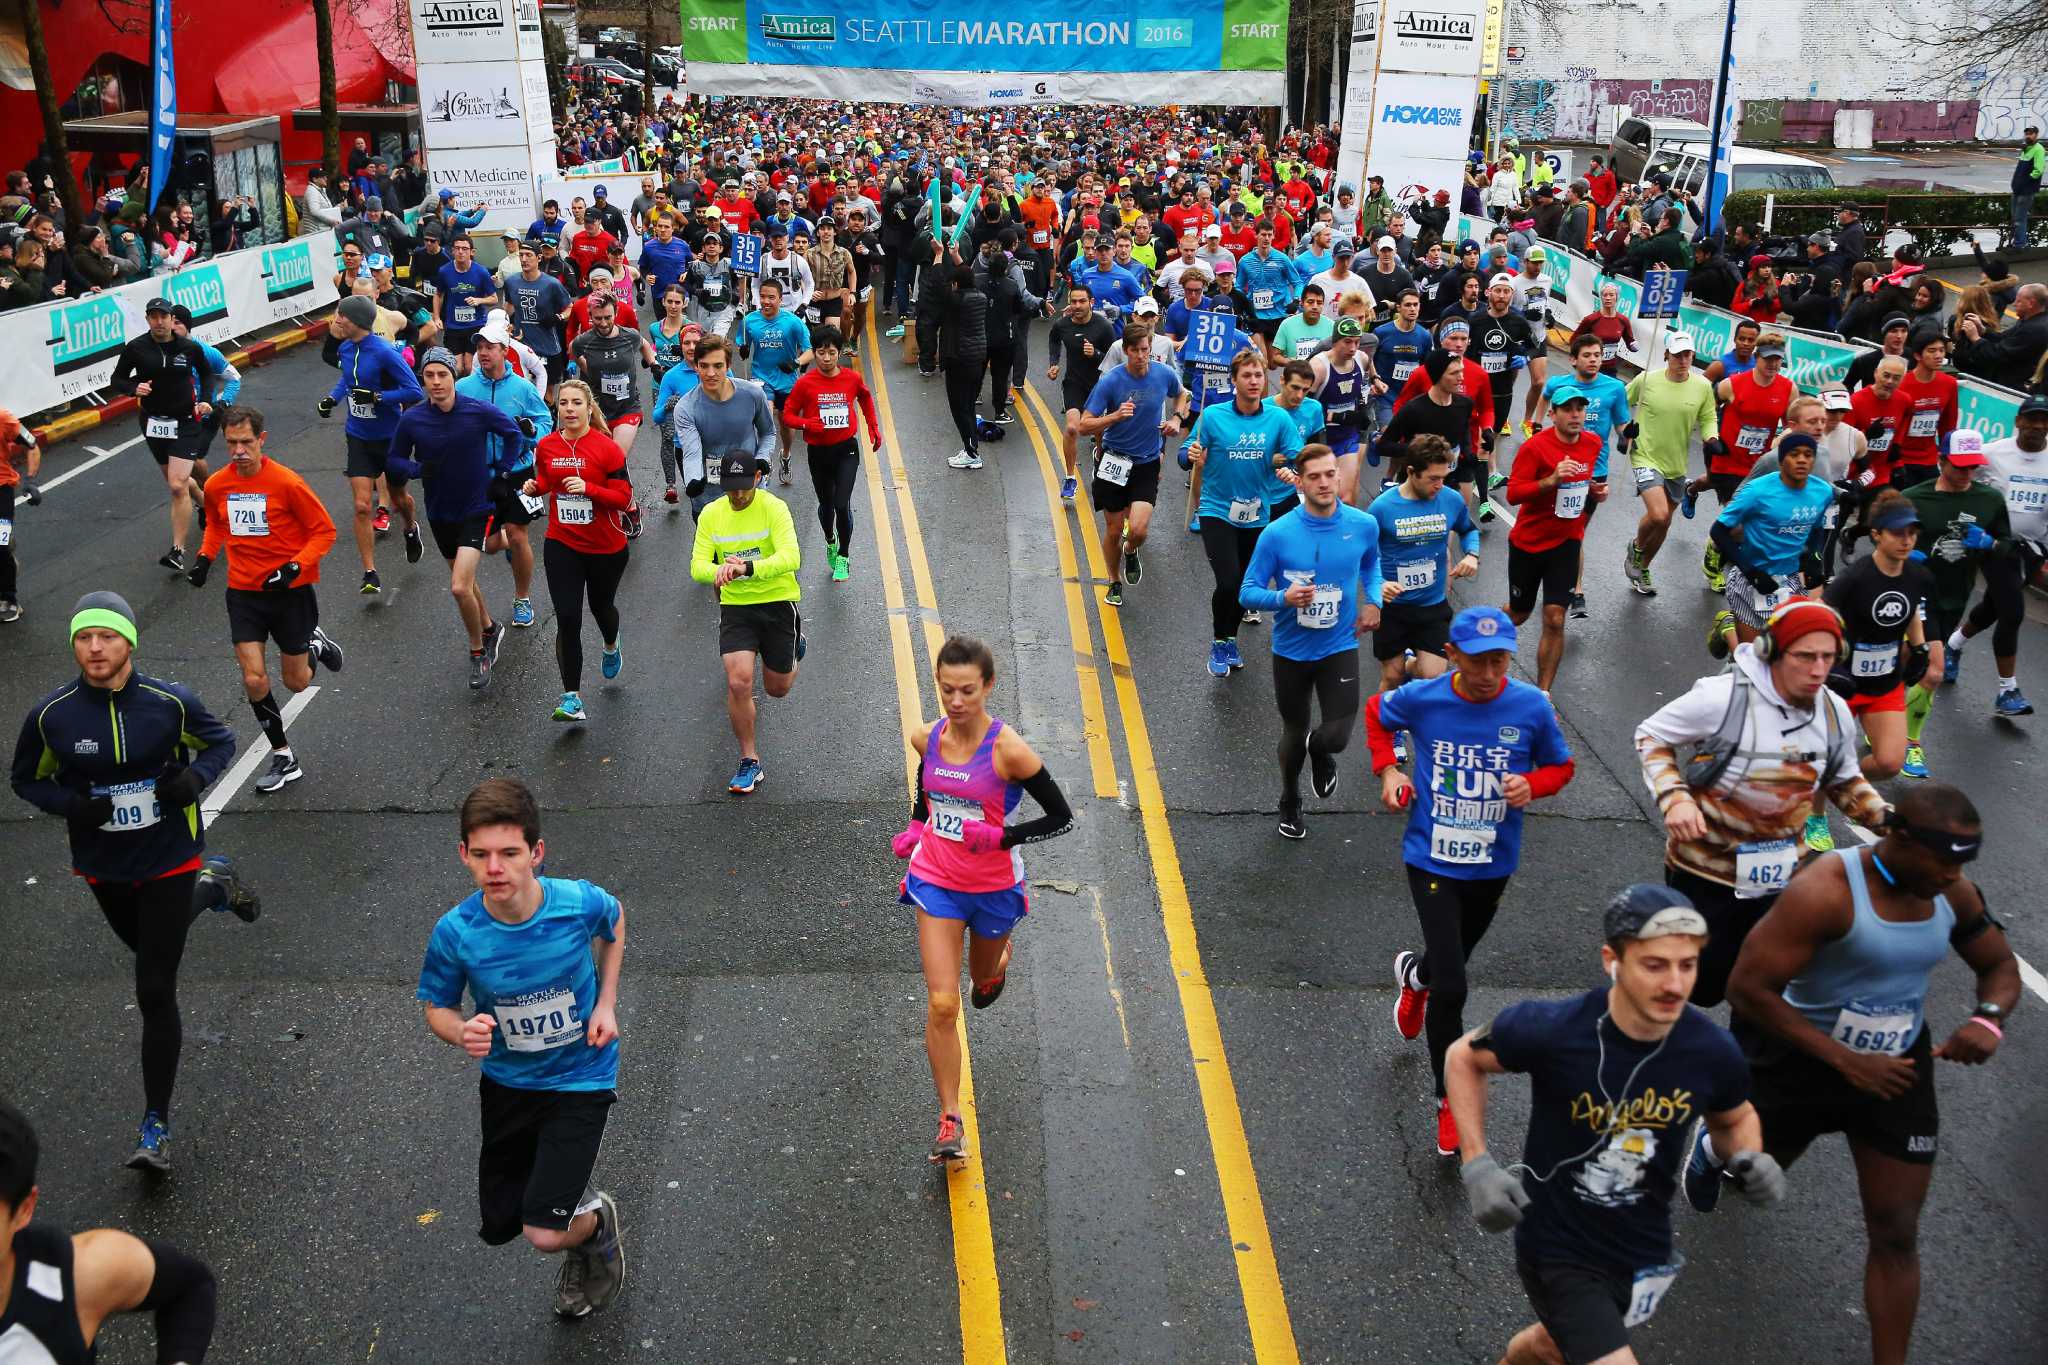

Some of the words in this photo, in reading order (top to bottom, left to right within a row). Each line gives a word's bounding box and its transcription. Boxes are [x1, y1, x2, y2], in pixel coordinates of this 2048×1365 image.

[424, 3, 498, 23] Amica
[1353, 6, 1375, 31] mica
[689, 17, 738, 30] START
[764, 16, 831, 36] Amica
[1396, 11, 1470, 34] Amica
[1143, 26, 1183, 42] 2016
[1231, 24, 1280, 38] START
[989, 89, 1013, 98] HOKA
[1382, 105, 1439, 125] HOKA
[1439, 108, 1461, 117] ONE
[1439, 117, 1462, 126] ONE
[433, 171, 462, 184] UW
[464, 168, 528, 183] Medicine
[483, 189, 508, 197] SPINE
[510, 188, 516, 196] &
[496, 195, 528, 205] HEALTH
[736, 235, 755, 250] 3h
[737, 251, 754, 264] 15
[266, 249, 310, 288] Amica
[522, 308, 537, 320] 15
[54, 306, 123, 357] Amica
[1196, 315, 1226, 335] 3h
[1197, 335, 1223, 354] 10
[659, 355, 682, 363] PACER
[1195, 363, 1229, 373] MARATHON
[61, 380, 82, 397] AUTO
[87, 371, 109, 387] HOME
[606, 384, 622, 393] 654
[823, 415, 845, 426] 1662
[151, 425, 169, 437] 430
[1229, 451, 1264, 460] PACER
[1563, 496, 1581, 508] 302
[2009, 490, 2038, 504] 1648
[234, 510, 256, 524] 720
[561, 508, 586, 521] 1504
[1394, 513, 1447, 526] CALIFORNIA
[1396, 524, 1447, 537] MARATHON
[1405, 572, 1427, 586] 393
[1861, 659, 1885, 674] 917
[1432, 738, 1512, 771] 君乐宝
[934, 767, 970, 782] saucony
[109, 780, 143, 791] SEATTLE
[112, 805, 141, 826] 09
[935, 811, 963, 835] 122
[1025, 818, 1075, 844] saucony
[1437, 838, 1482, 858] 1659
[1748, 864, 1783, 884] 462
[516, 987, 557, 1002] SEATTLE
[518, 988, 570, 1007] MARATHON
[506, 1010, 565, 1036] 1970
[1840, 1025, 1899, 1051] 1692
[1571, 1087, 1692, 1132] Angelo's
